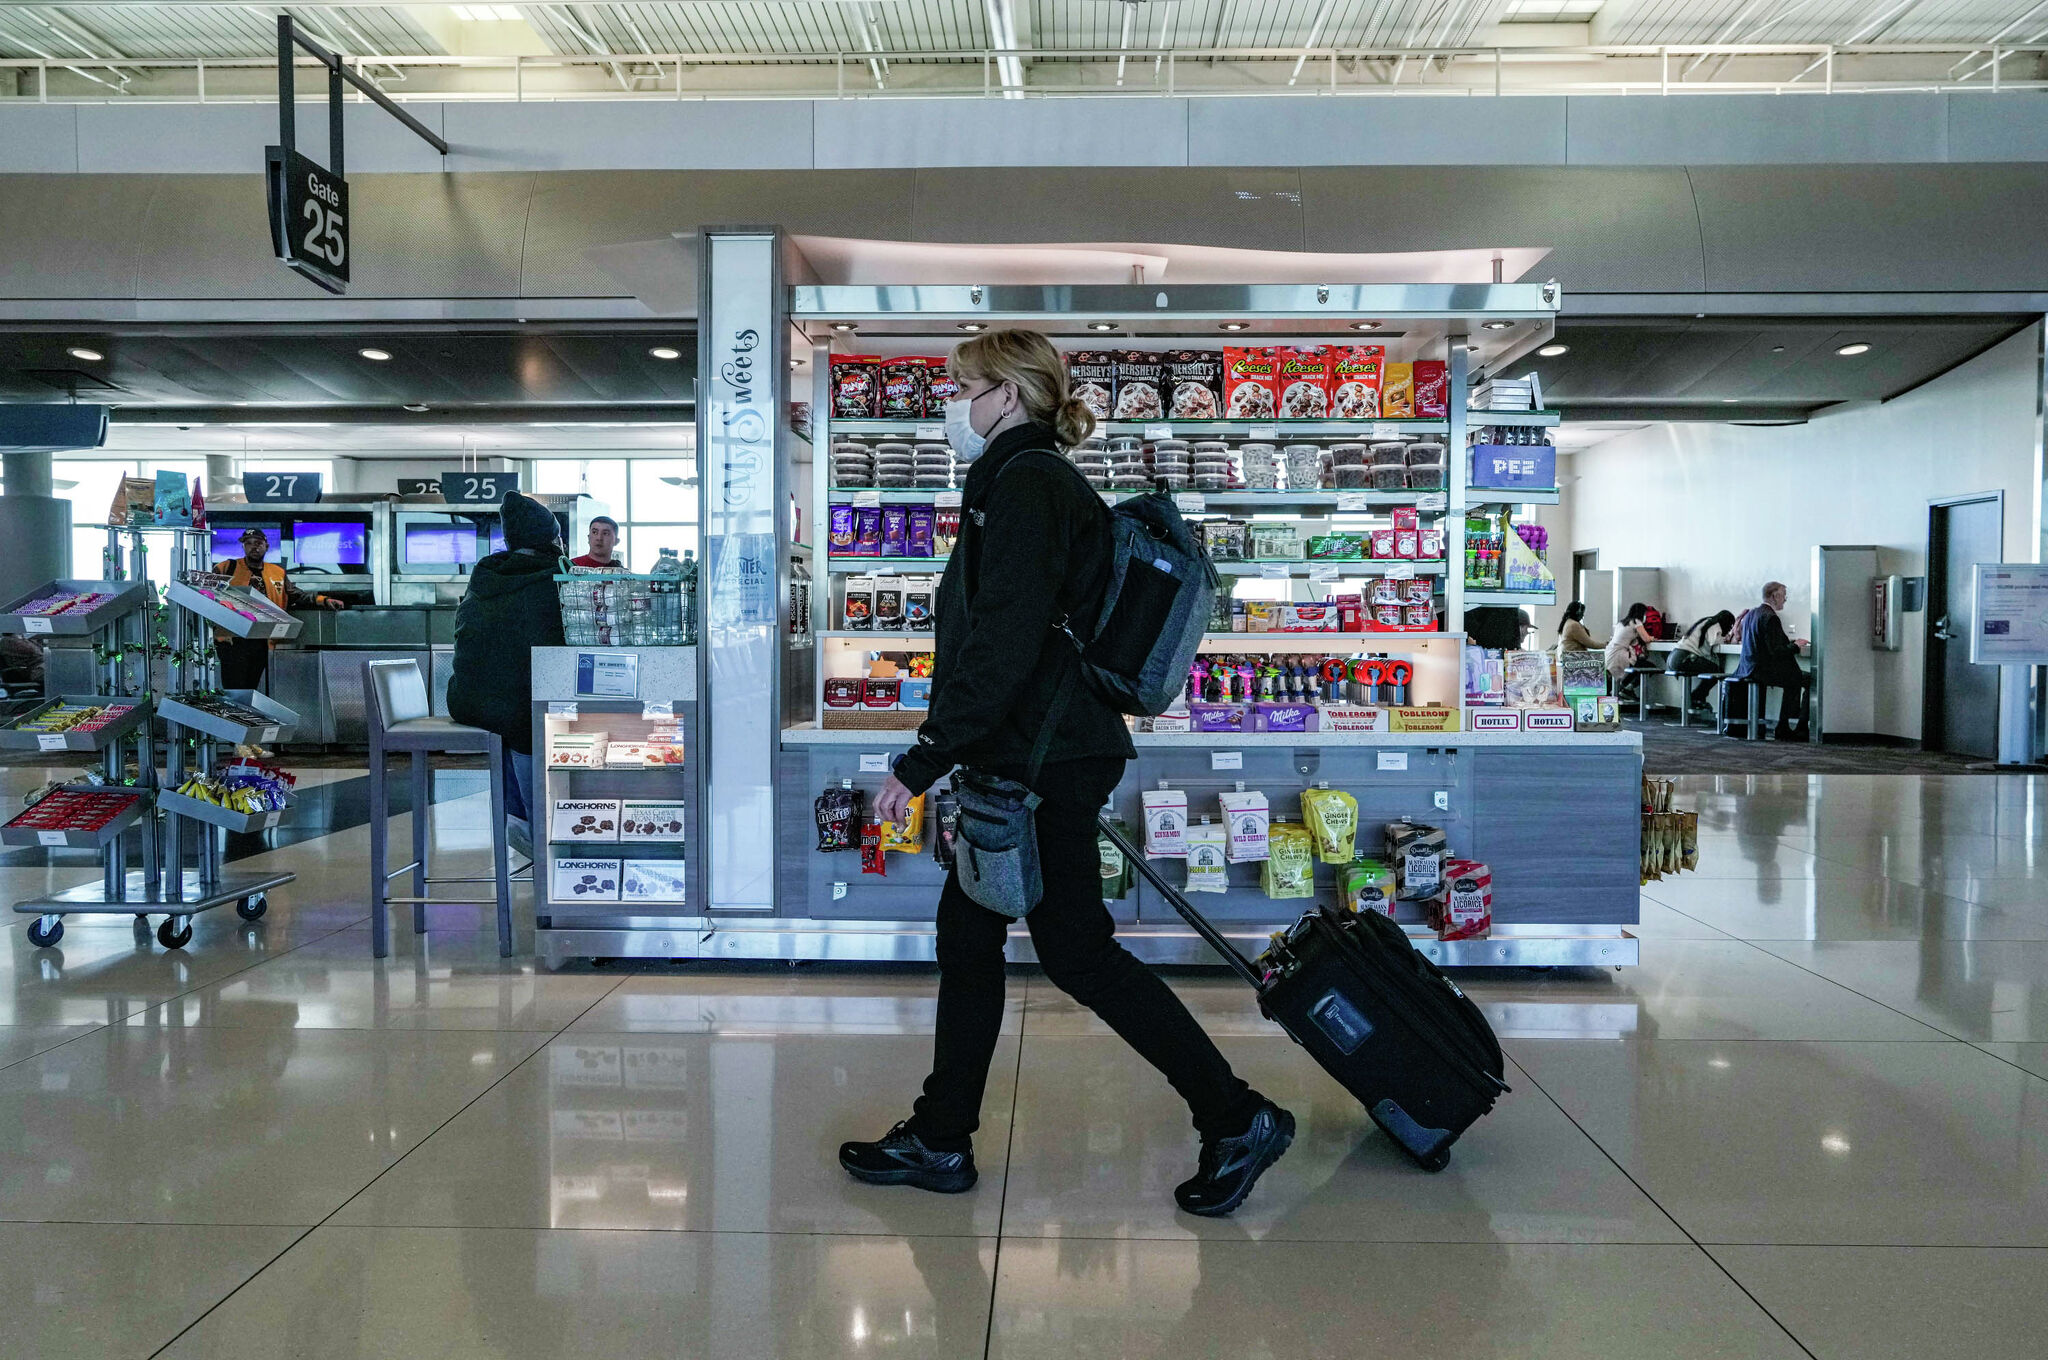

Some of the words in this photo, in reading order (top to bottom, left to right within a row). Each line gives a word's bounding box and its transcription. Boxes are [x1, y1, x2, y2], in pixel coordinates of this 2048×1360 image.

[308, 172, 339, 207] Gate
[303, 198, 345, 267] 25
[1119, 363, 1160, 376] HERSHEY'S
[1232, 359, 1272, 374] Reese's
[1282, 358, 1325, 374] Reese's
[1334, 359, 1377, 374] Reese's
[721, 329, 766, 443] Sweets
[840, 381, 868, 392] PANDA
[886, 384, 914, 394] PANDA
[931, 384, 959, 394] PANDA
[1493, 459, 1535, 474] PEZ
[265, 475, 298, 497] 27
[415, 482, 440, 494] 25
[464, 478, 496, 500] 25
[1202, 712, 1225, 722] Milka
[1270, 708, 1300, 722] Milka
[1328, 710, 1377, 719] TOBLERONE
[1398, 710, 1450, 718] TOBLERONE
[556, 802, 616, 810] LONGHORNS
[558, 861, 617, 869] LONGHORNS
[1408, 865, 1437, 873] LICORICE
[1454, 901, 1482, 909] LICORICE
